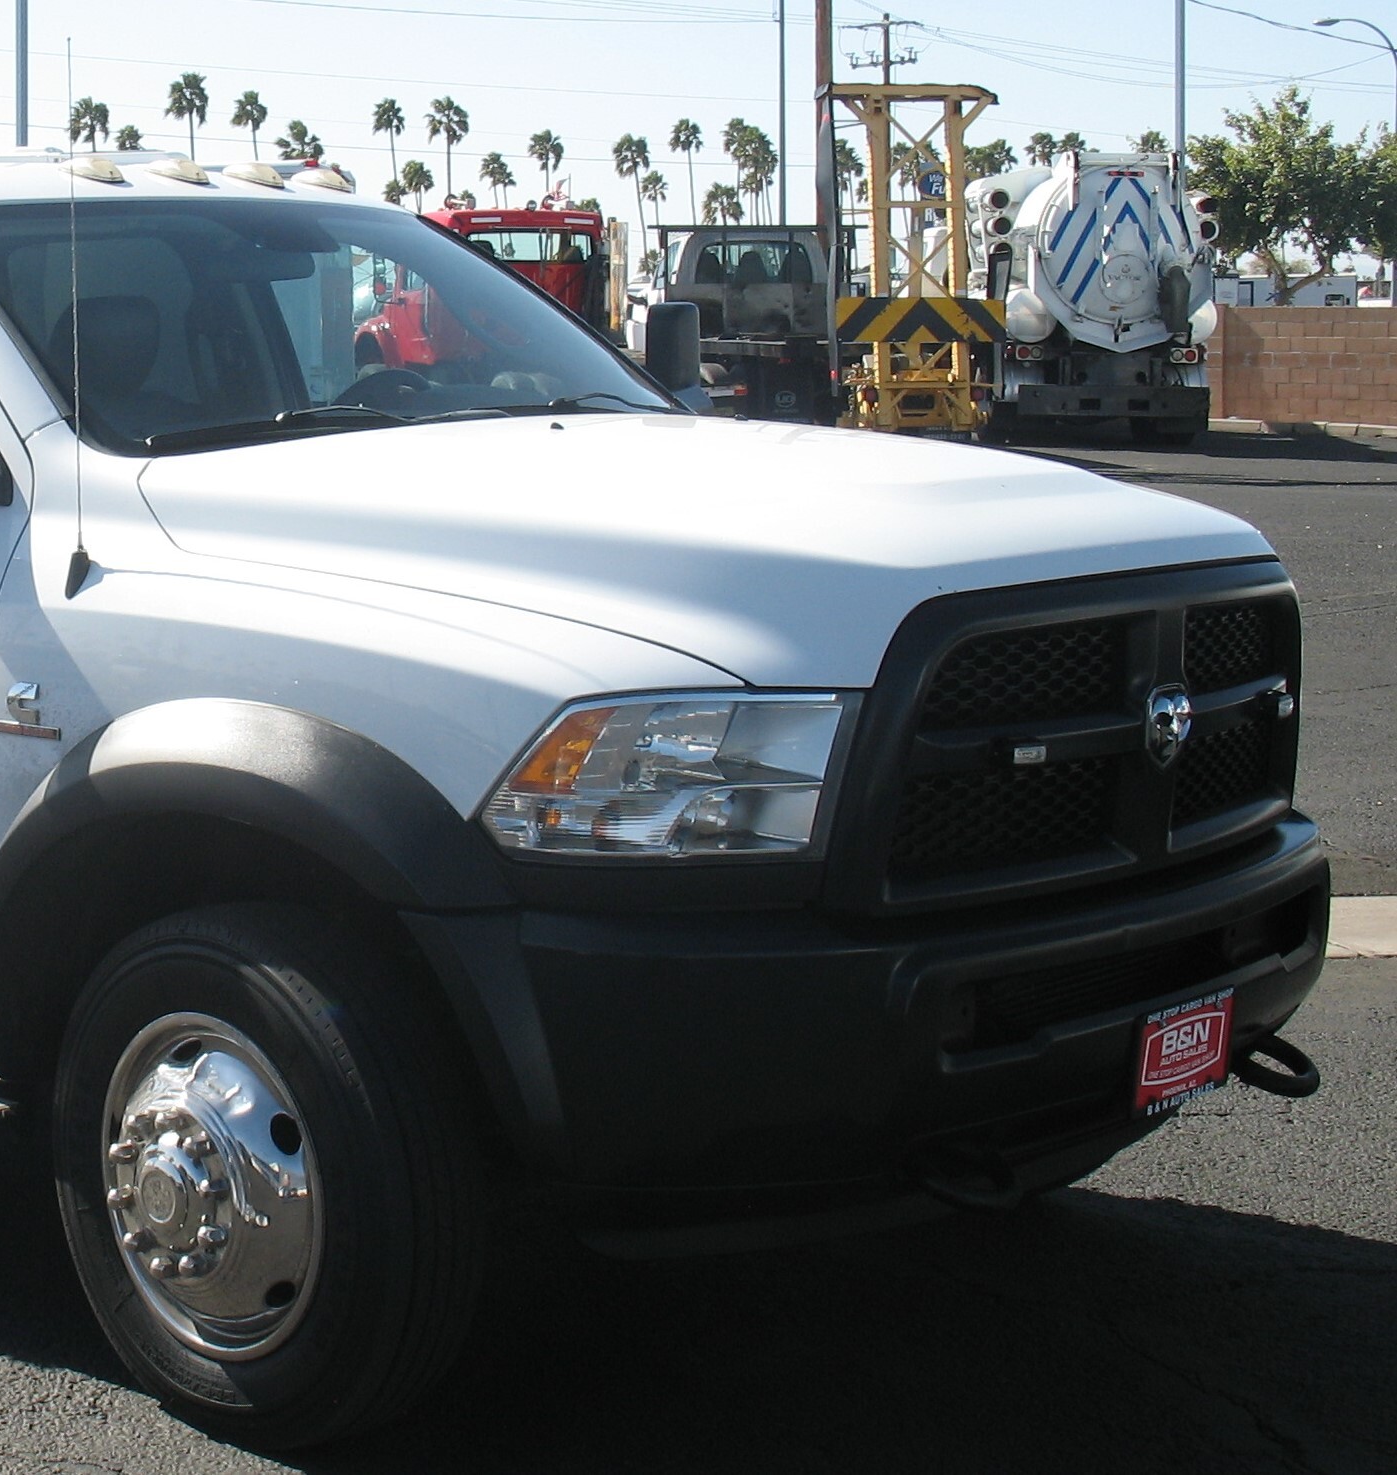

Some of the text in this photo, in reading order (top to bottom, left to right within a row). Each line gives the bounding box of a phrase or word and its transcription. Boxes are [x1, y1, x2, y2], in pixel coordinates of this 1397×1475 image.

[1162, 1006, 1180, 1020] STOP
[1161, 1018, 1211, 1057] B&N
[1159, 1043, 1208, 1067] AUTO SALES
[1170, 1091, 1190, 1107] AUTO
[1191, 1081, 1214, 1097] SALES
